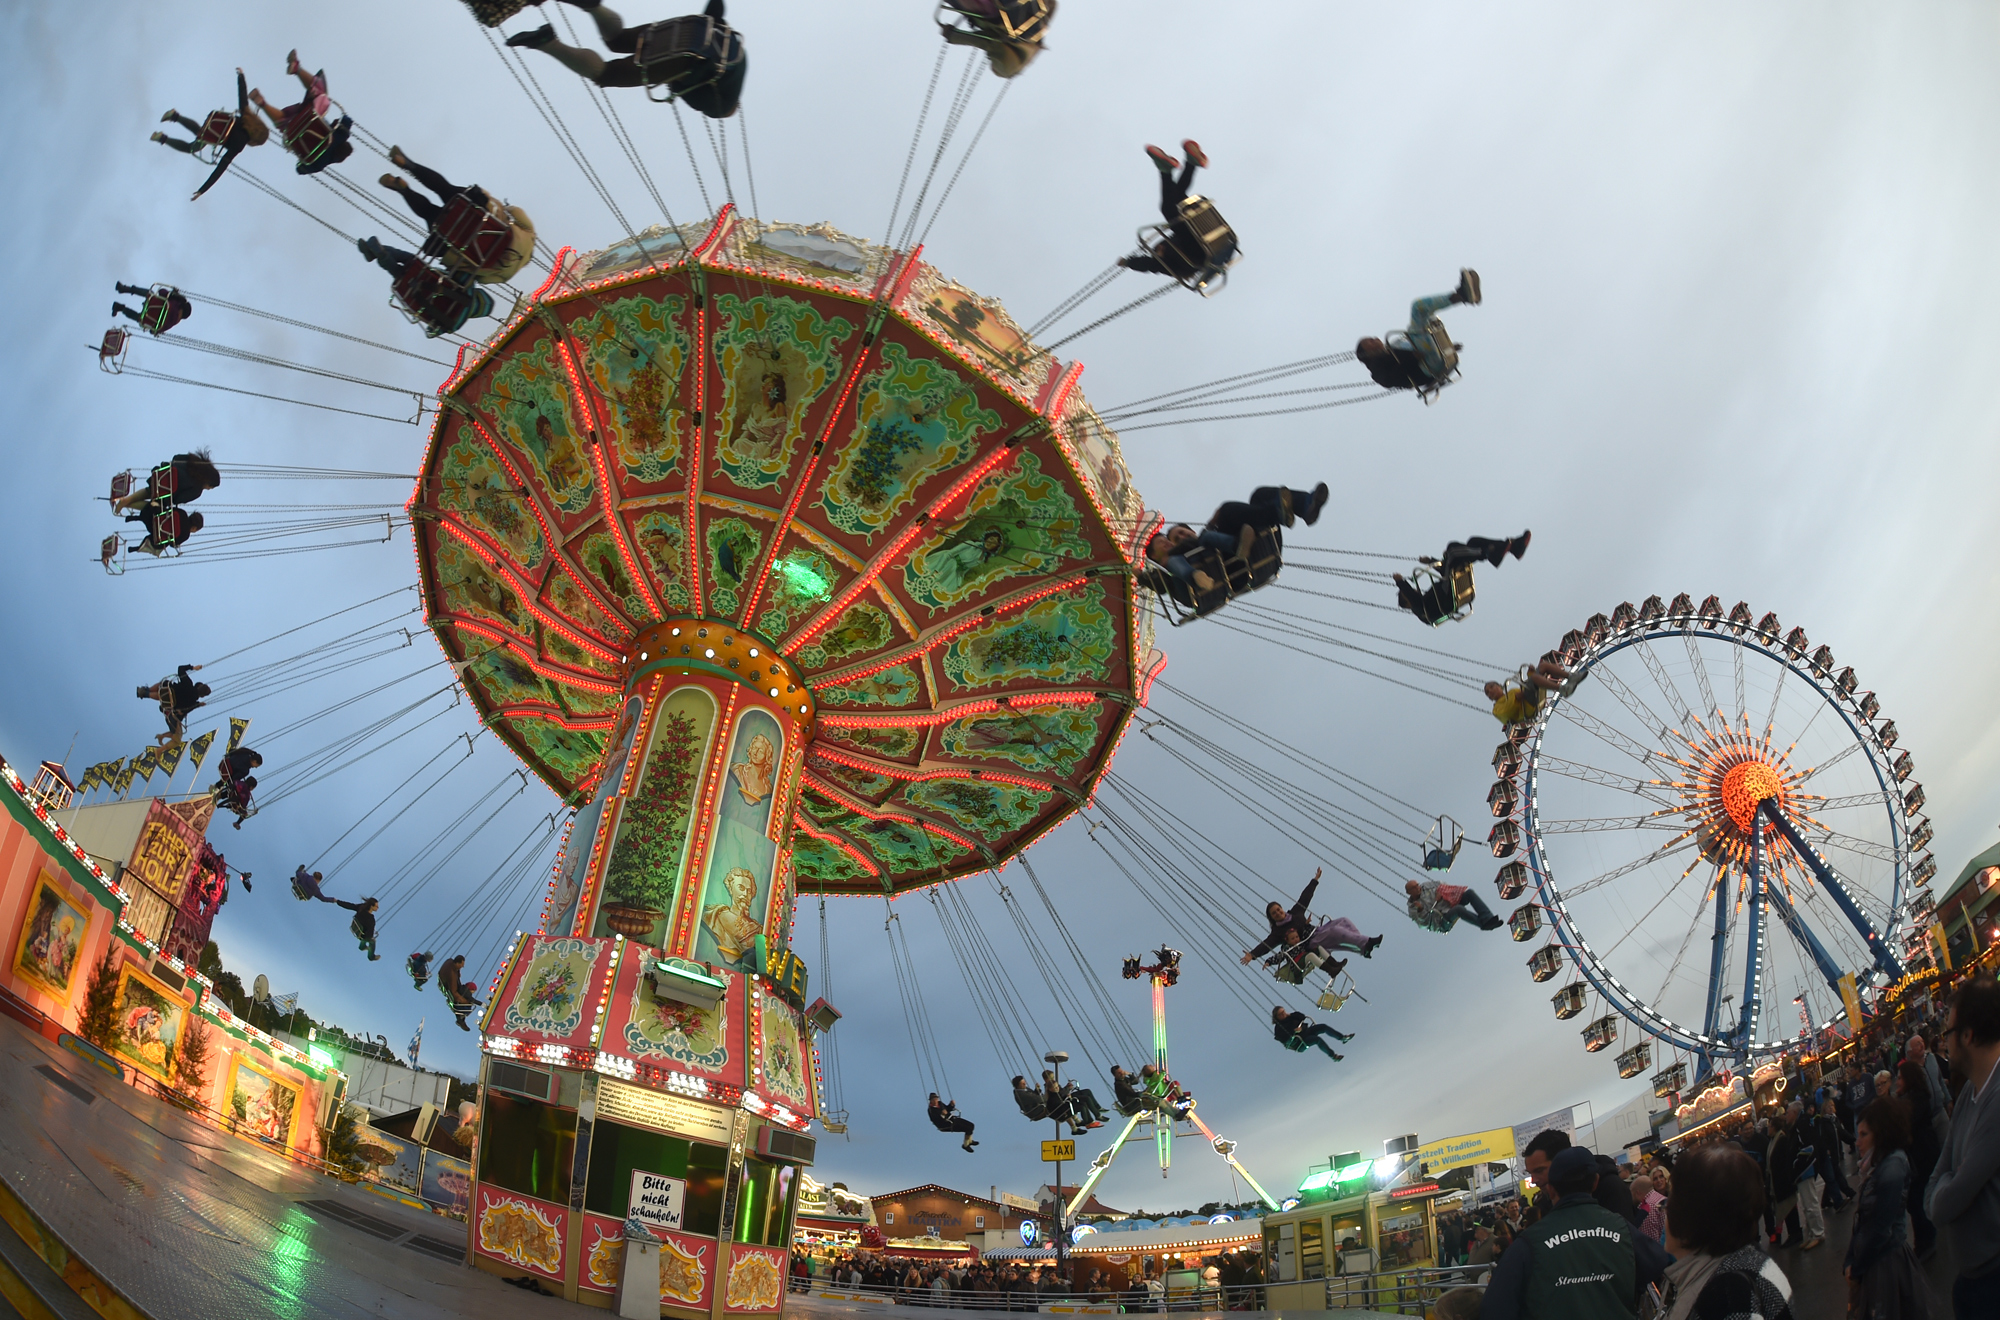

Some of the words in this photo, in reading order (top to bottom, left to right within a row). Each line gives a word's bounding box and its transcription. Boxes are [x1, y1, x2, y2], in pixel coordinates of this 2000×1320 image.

[146, 822, 193, 872] FAHRT
[149, 841, 176, 871] ZUR
[1885, 966, 1940, 1003] Willenborg
[1052, 1144, 1073, 1156] TAXI
[1446, 1139, 1482, 1152] Tradition
[1442, 1147, 1490, 1164] Willkommen
[642, 1176, 671, 1192] Bitte
[641, 1192, 669, 1206] nicht
[630, 1205, 680, 1223] schaukeln!
[907, 1215, 962, 1226] TRADITION
[1544, 1226, 1620, 1249] Wellenflug
[1555, 1272, 1615, 1287] Stranninger
